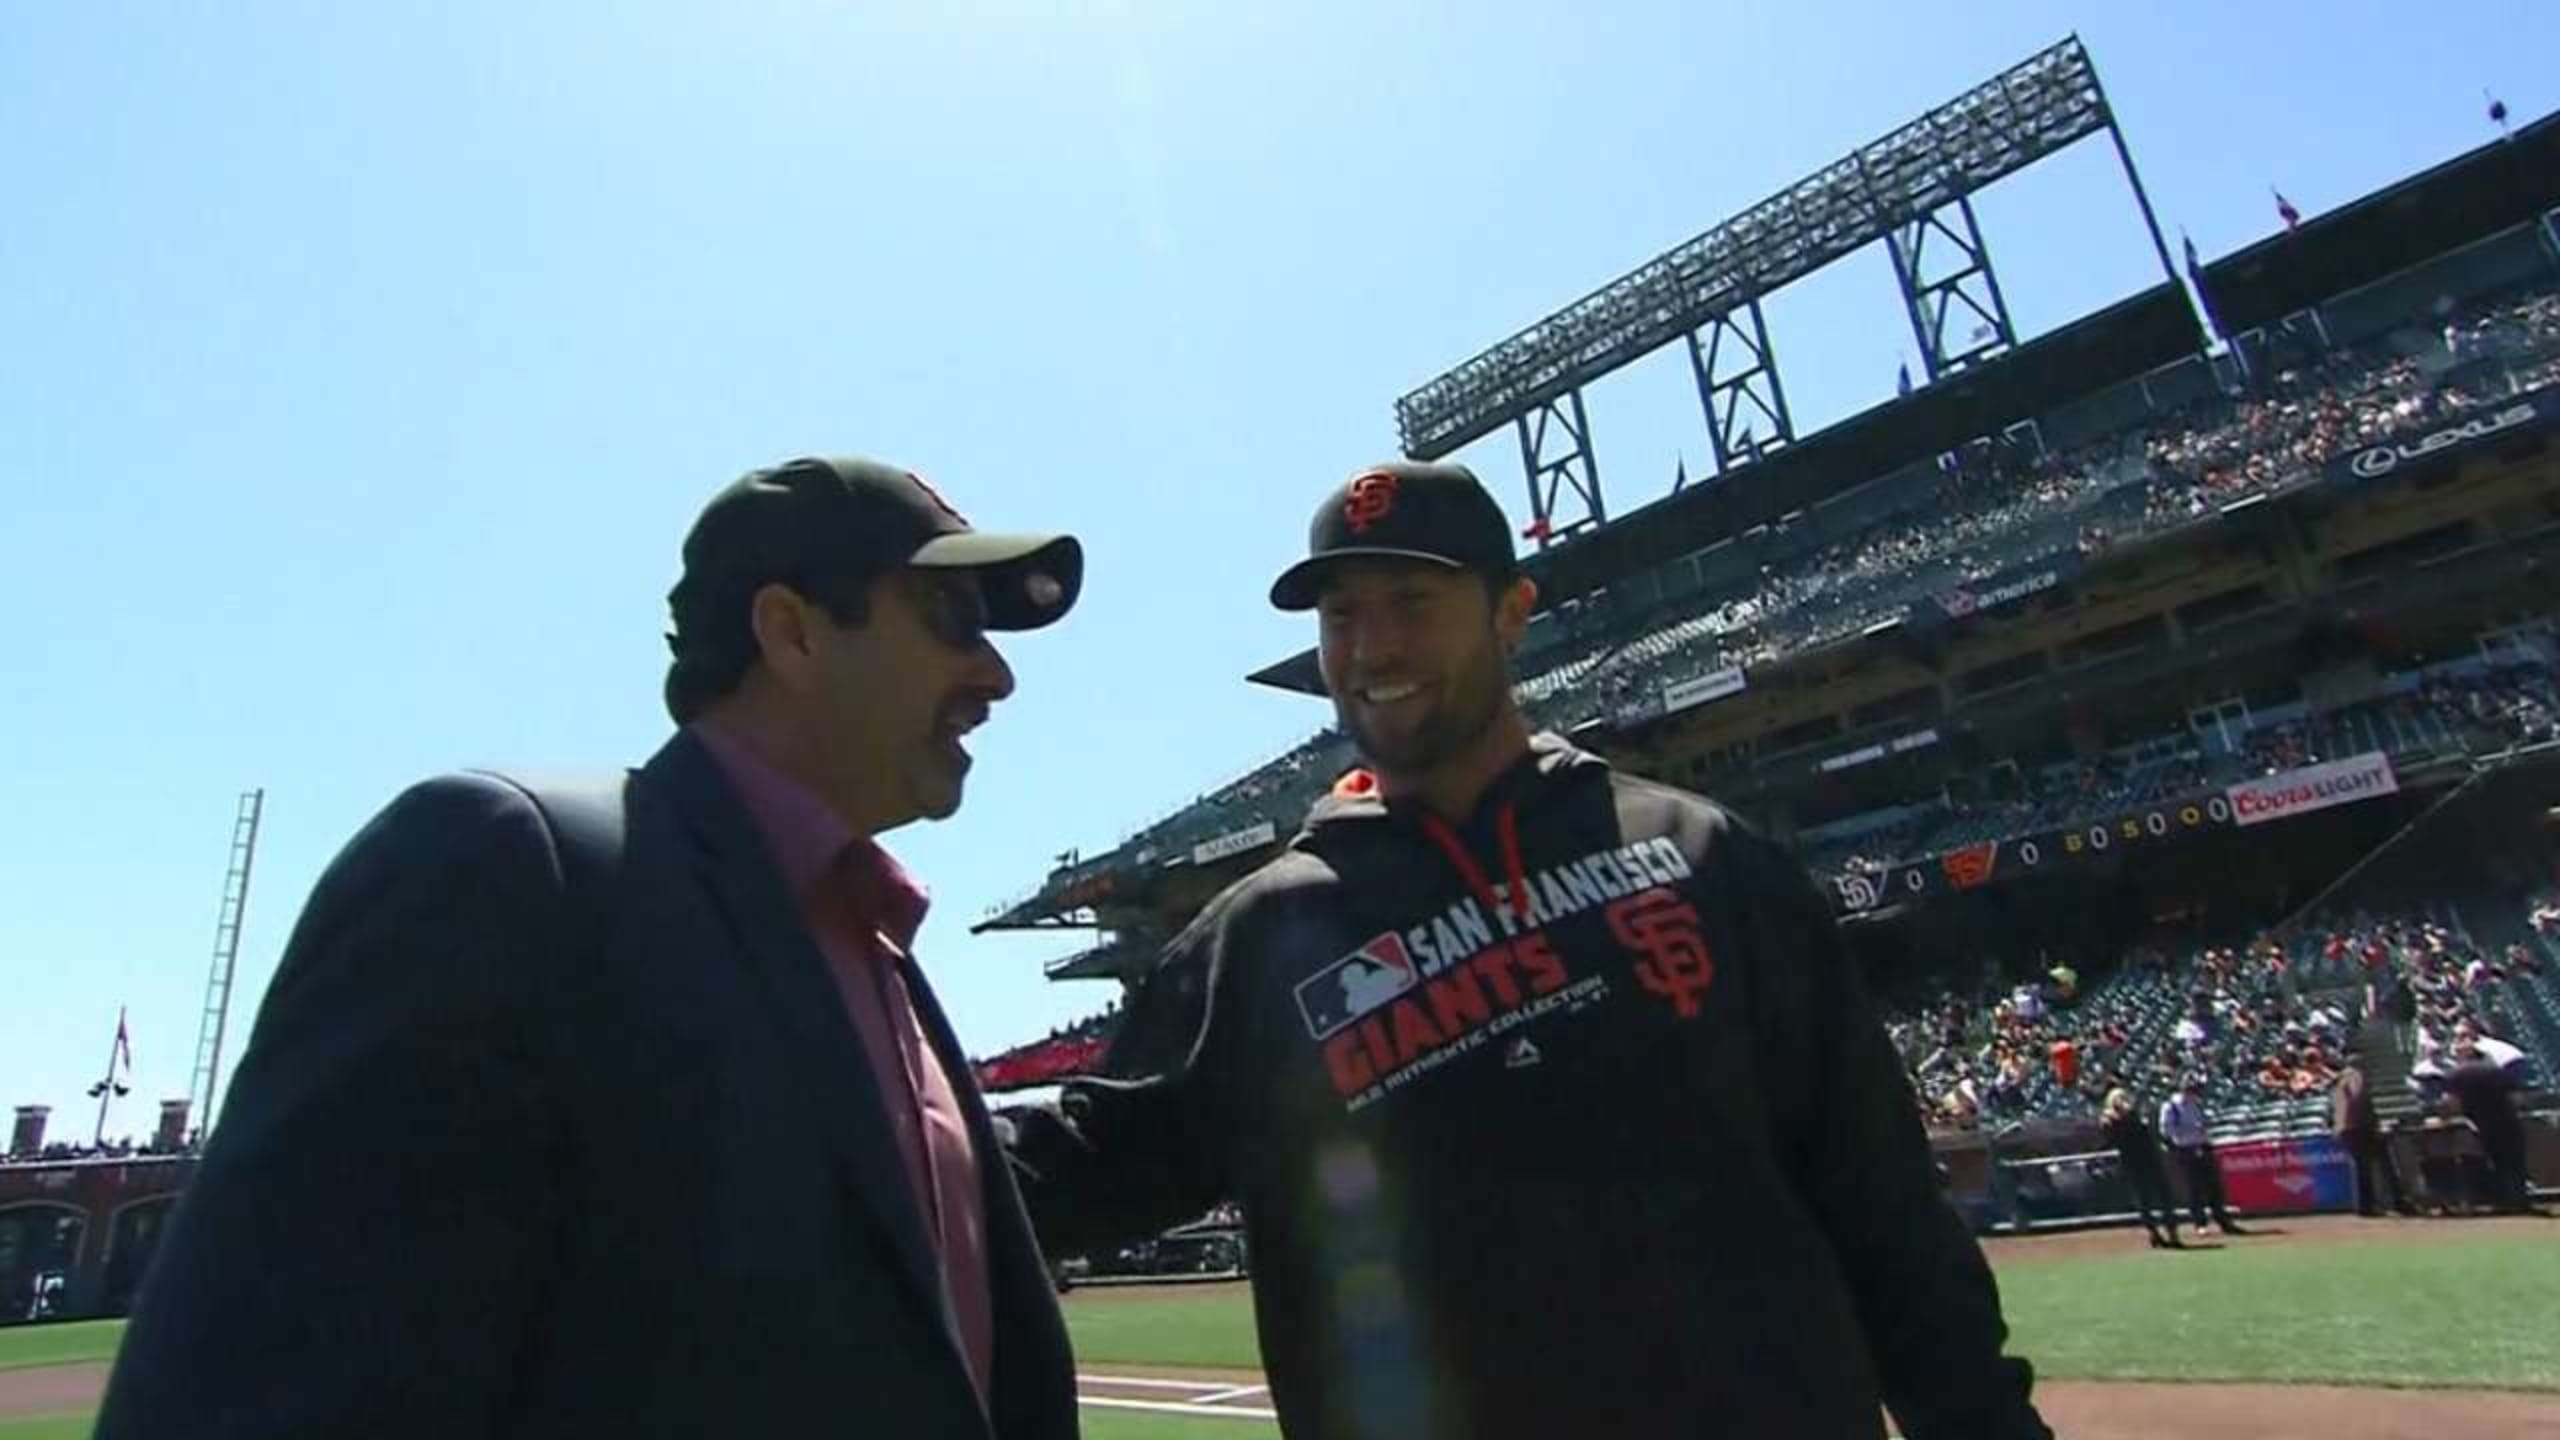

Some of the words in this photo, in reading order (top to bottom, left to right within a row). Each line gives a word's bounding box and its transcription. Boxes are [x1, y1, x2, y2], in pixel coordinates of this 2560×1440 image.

[2396, 402, 2537, 459] LEXUS
[1977, 571, 2057, 609] america
[2238, 783, 2314, 816] Coors
[2314, 767, 2386, 799] LIGHT
[1407, 896, 1492, 977] SAN
[1492, 835, 1693, 936] FRANCISCO
[1322, 932, 1569, 1100] GIANTS
[1384, 1030, 1488, 1090] AUTHENTIC
[1489, 975, 1603, 1034] COLLECTION
